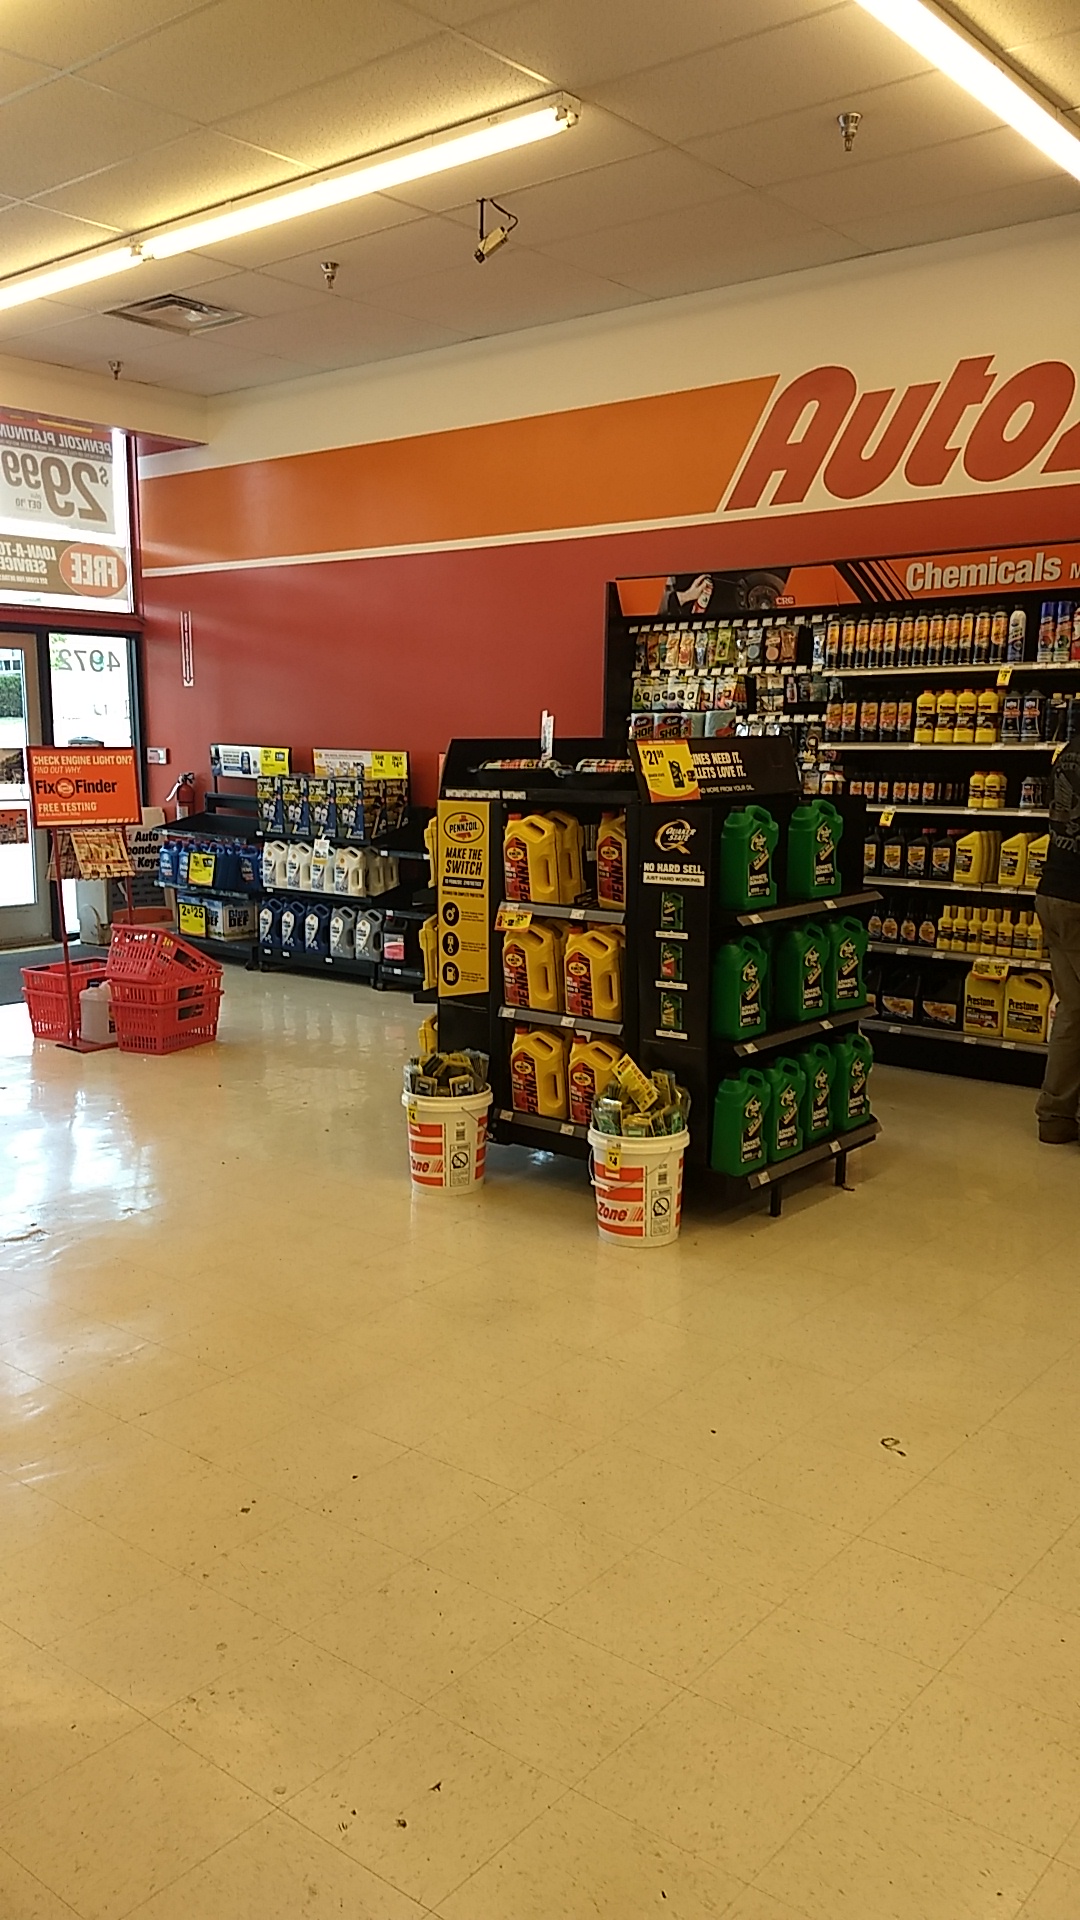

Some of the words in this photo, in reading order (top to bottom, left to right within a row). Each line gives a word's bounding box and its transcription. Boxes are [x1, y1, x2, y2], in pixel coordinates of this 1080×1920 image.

[905, 552, 1062, 592] Chemicals
[776, 596, 794, 605] CRC
[33, 756, 60, 766] CHECK
[61, 756, 91, 765] ENGINE
[92, 756, 115, 765] LIGHT
[116, 755, 132, 765] ON?
[712, 752, 732, 764] NEED
[732, 752, 742, 764] IT.
[34, 766, 48, 774] FIND
[50, 766, 64, 774] OUT
[694, 766, 716, 780] LLETS
[717, 766, 736, 778] LOVE
[736, 765, 746, 777] IT.
[36, 780, 56, 794] Fix
[75, 778, 117, 794] Finder
[706, 786, 720, 794] MORE
[38, 802, 59, 812] FREE
[61, 802, 97, 812] TESTING
[449, 821, 478, 834] PENNZOIL
[135, 831, 158, 842] Auto
[446, 847, 467, 860] MAKE
[468, 848, 483, 860] THE
[137, 857, 160, 870] Keys
[446, 860, 483, 876] SWITCH
[644, 862, 655, 872] NO
[656, 862, 680, 873] HARD
[682, 864, 705, 874] SELL.
[228, 910, 249, 918] Blue
[228, 917, 249, 928] DEF
[966, 994, 995, 1008] Prestone
[1008, 998, 1039, 1012] Prestone
